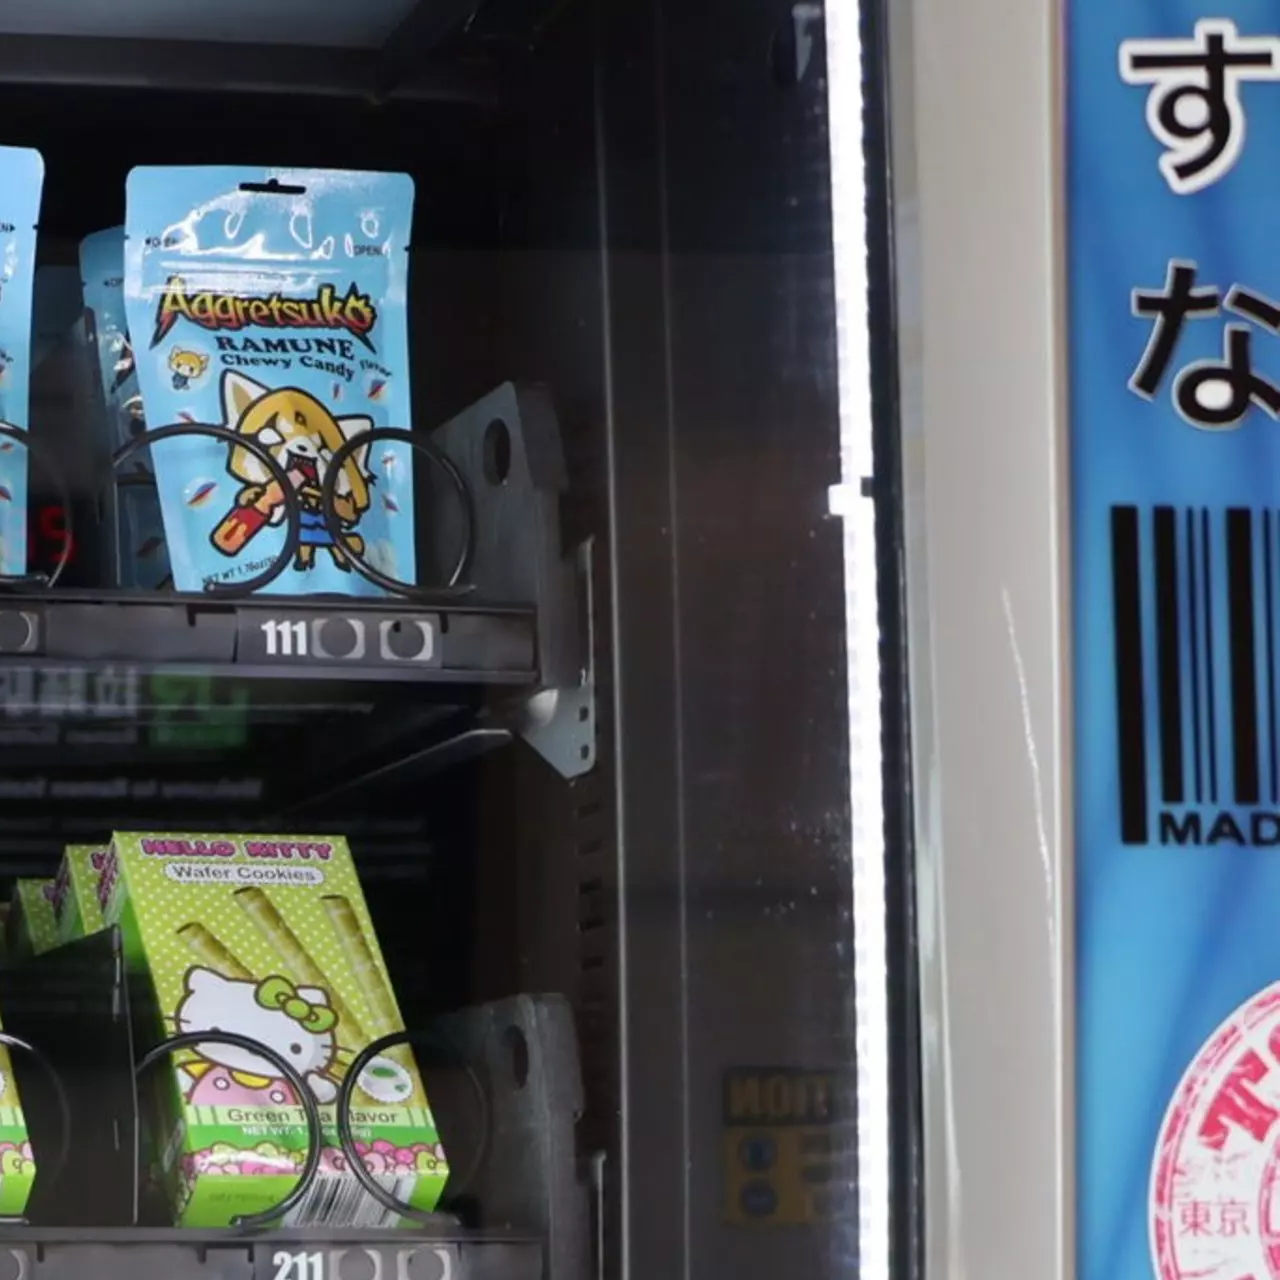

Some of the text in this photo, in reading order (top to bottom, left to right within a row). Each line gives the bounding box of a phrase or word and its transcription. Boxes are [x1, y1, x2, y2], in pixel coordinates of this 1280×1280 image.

[149, 275, 378, 355] Aggretsuko
[214, 335, 355, 361] RAMUNE
[219, 353, 357, 383] Chewy Candy
[260, 619, 309, 656] 111
[141, 838, 333, 861] HELLO KITTY
[173, 864, 316, 883] Wafer Cookies
[227, 1107, 399, 1125] Green Ta lavor
